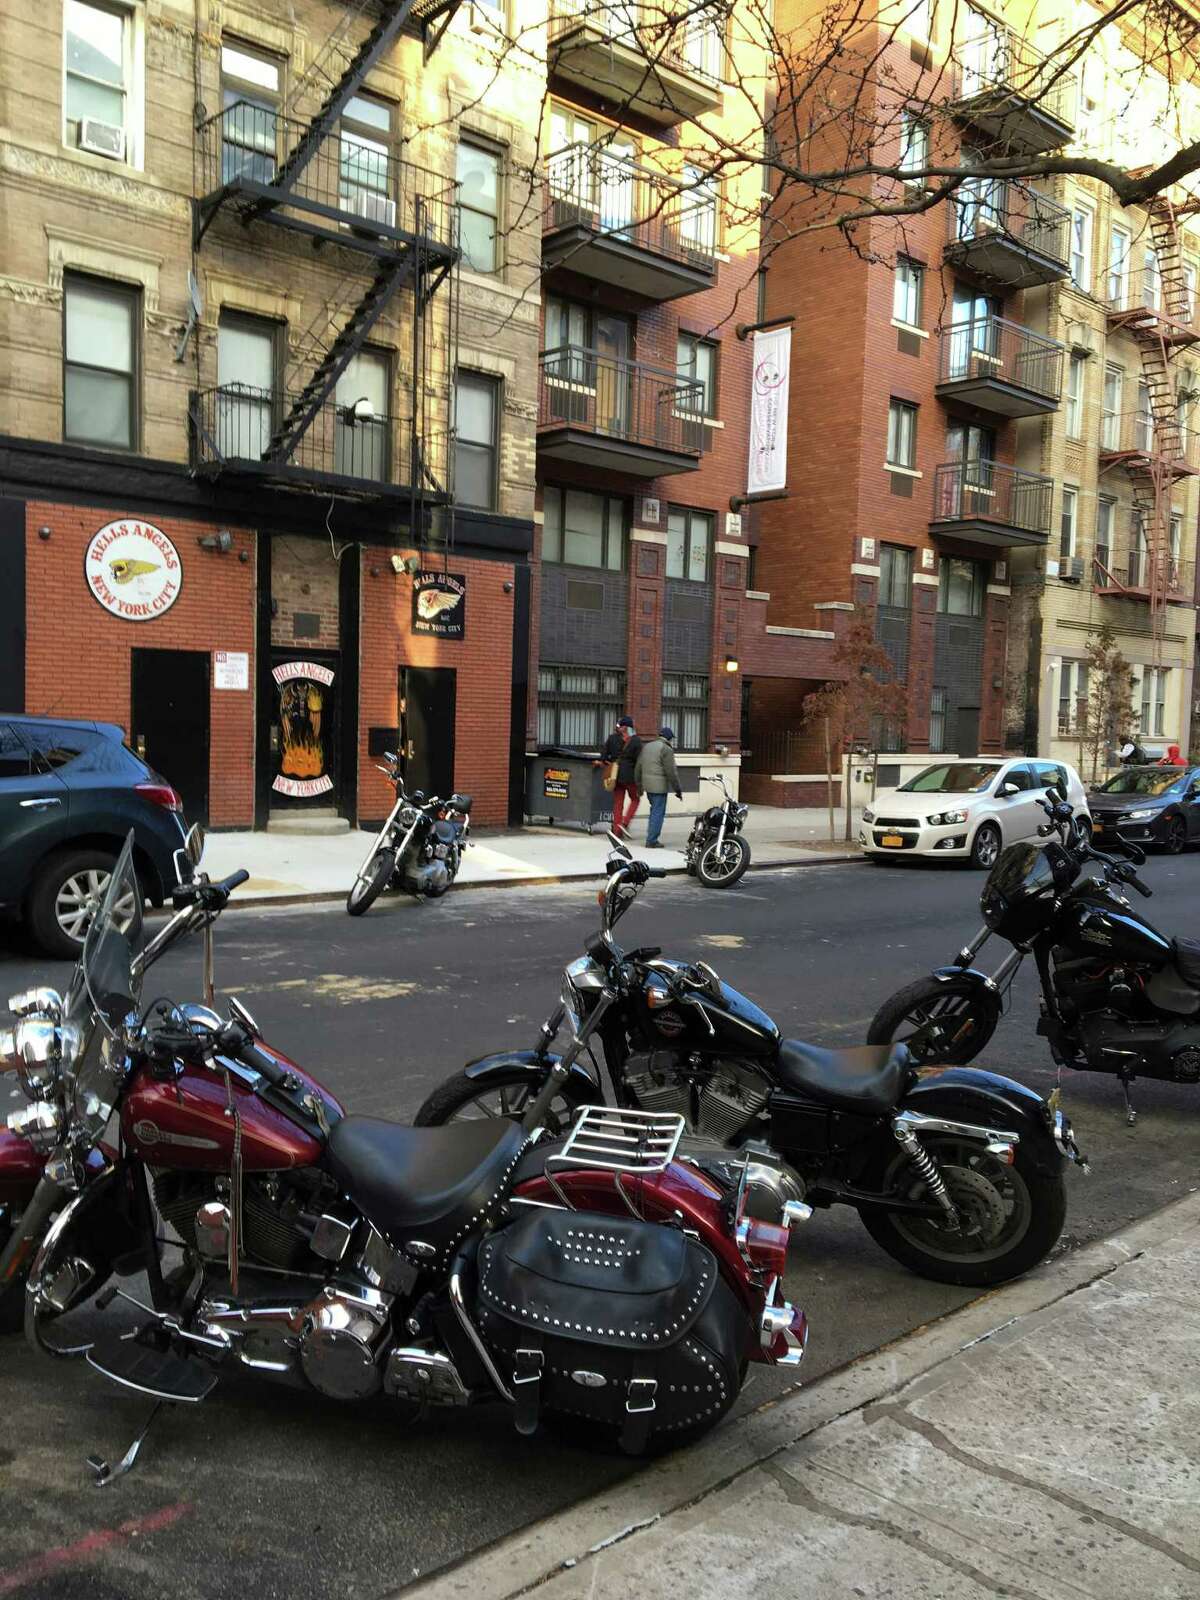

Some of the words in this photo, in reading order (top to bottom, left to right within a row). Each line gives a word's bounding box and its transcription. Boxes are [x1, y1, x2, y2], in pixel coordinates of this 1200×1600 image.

[91, 524, 129, 562] HELLS
[133, 524, 178, 570] ANGELS
[413, 573, 435, 590] HLLS
[91, 575, 117, 605] NEW
[117, 599, 153, 616] YORK
[152, 580, 177, 610] CITY
[300, 662, 332, 684] ANGELS
[274, 776, 294, 793] NEW
